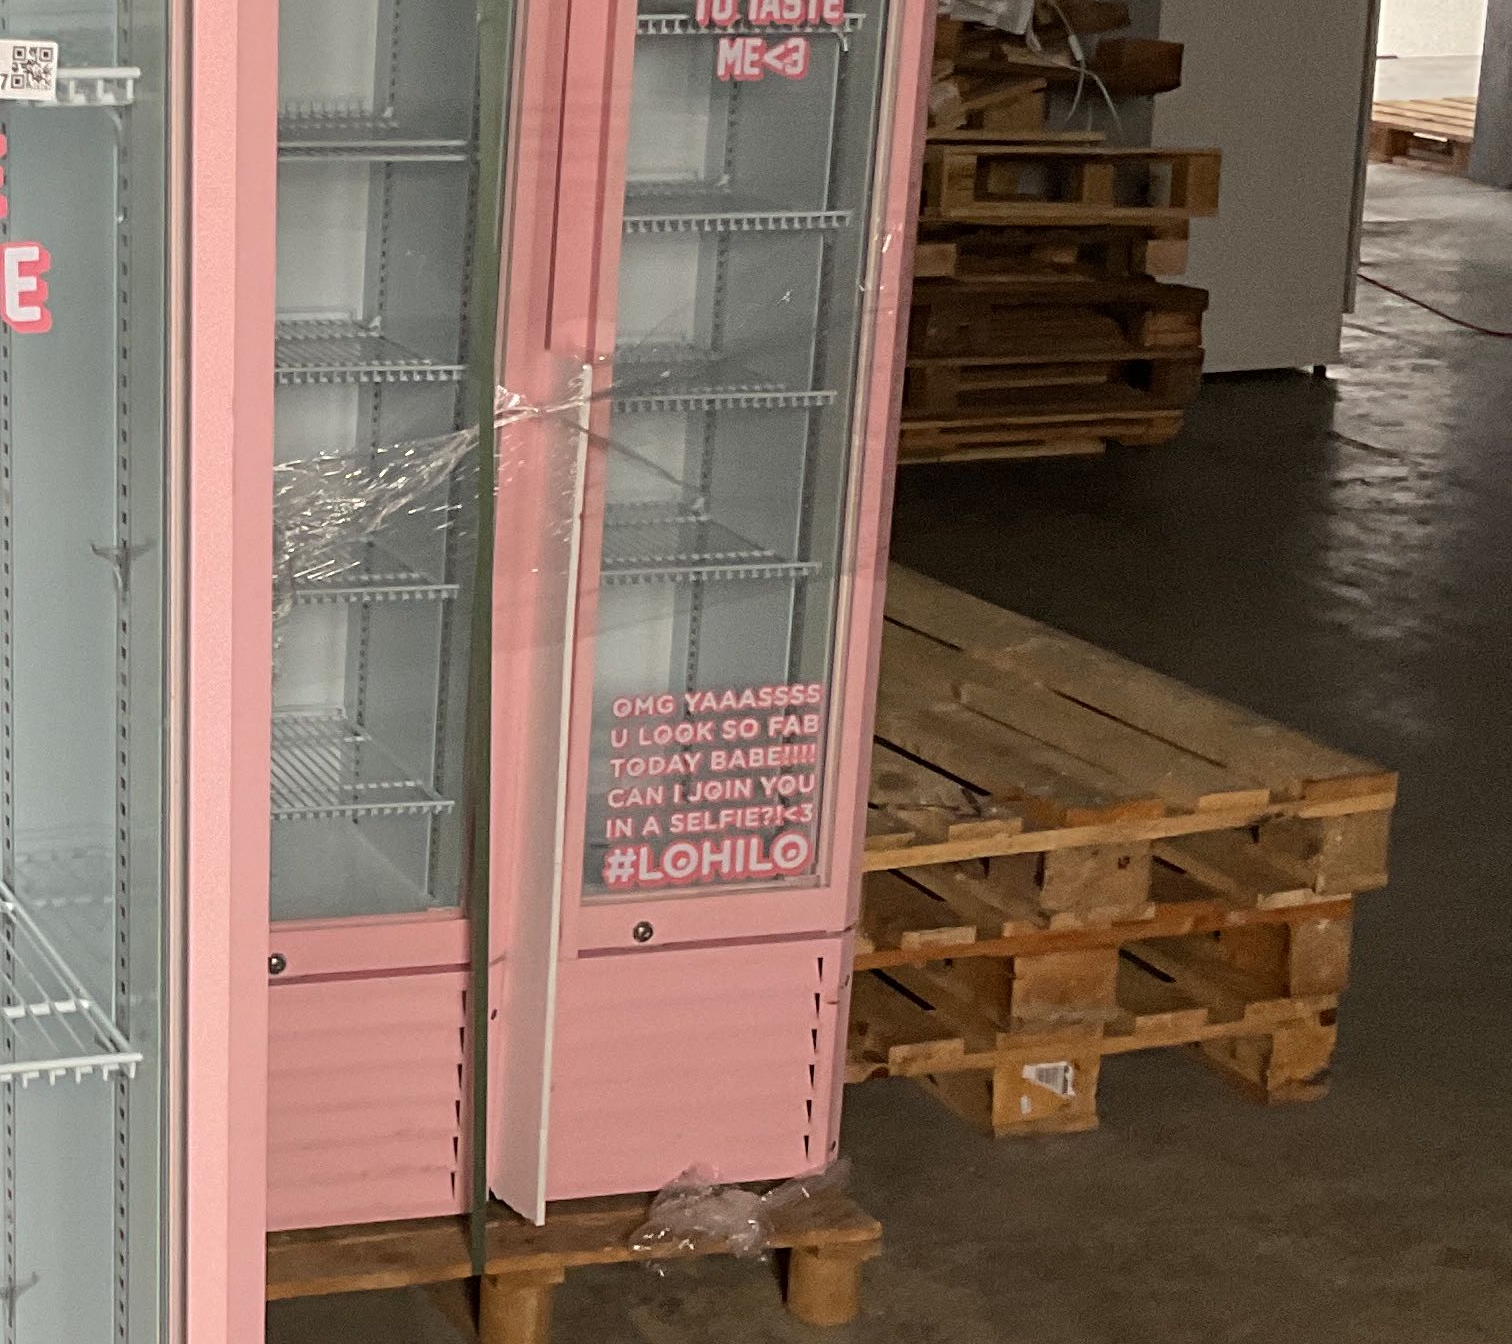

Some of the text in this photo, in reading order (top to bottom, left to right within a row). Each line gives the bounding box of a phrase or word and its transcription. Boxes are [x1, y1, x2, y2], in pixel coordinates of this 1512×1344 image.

[717, 37, 809, 80] ME<3
[613, 684, 822, 717] OMG YAAASSSS
[610, 714, 819, 748] U LOOK SO FAB
[610, 744, 816, 777] TODAY BABE!!!!
[607, 774, 815, 808] CAN I JOIN YOU
[605, 818, 632, 838] IN
[642, 816, 660, 835] A
[605, 832, 810, 886] #LOHILO
